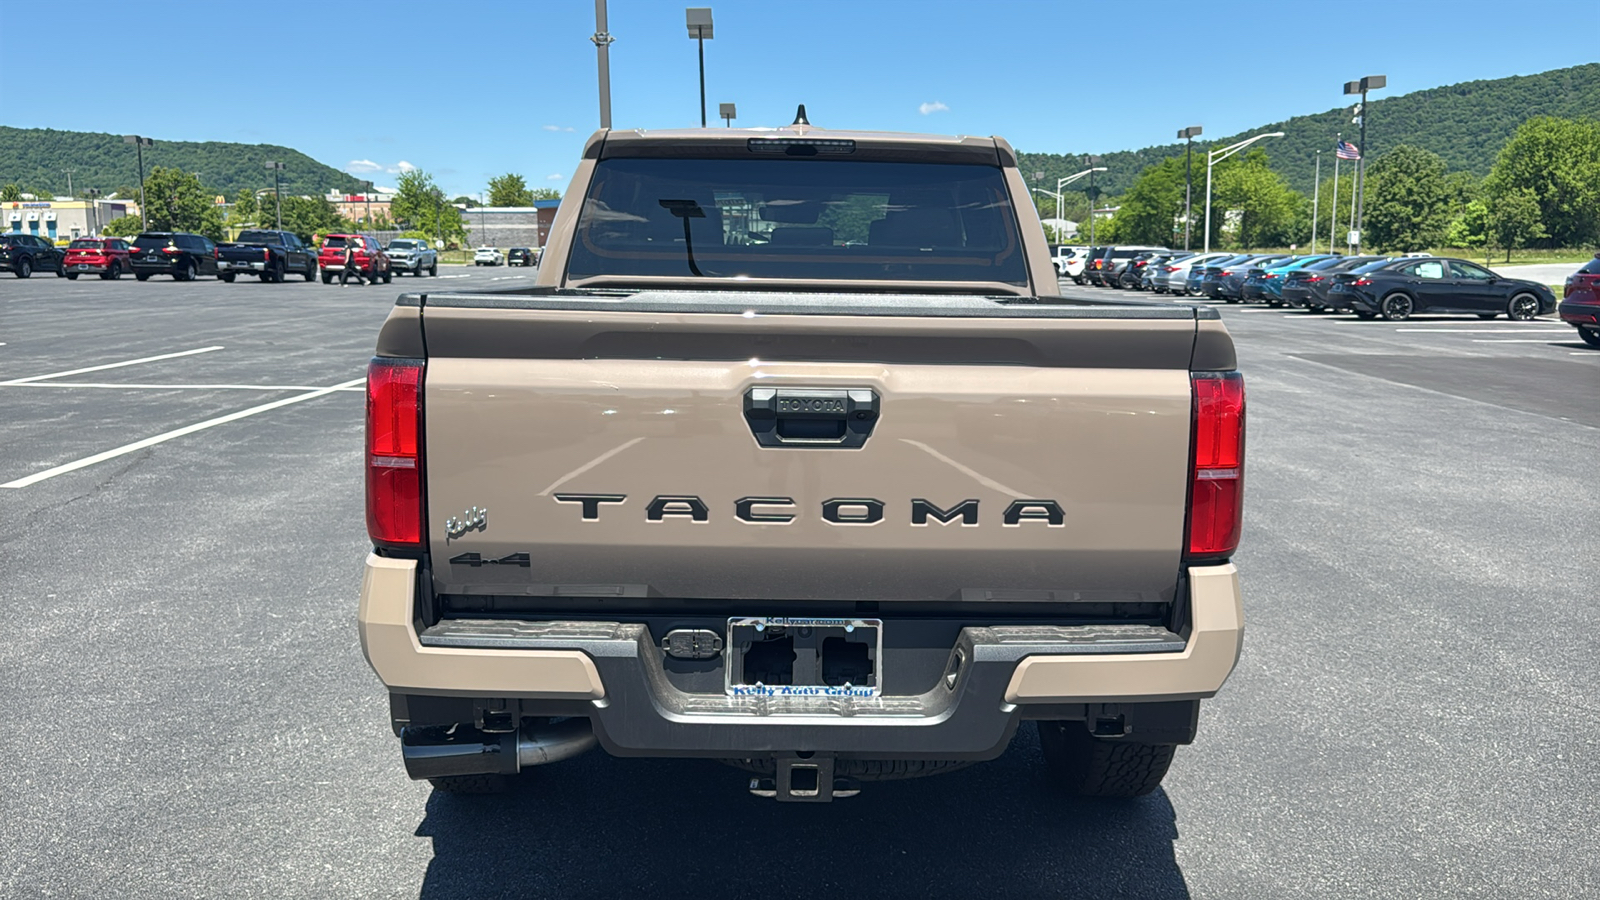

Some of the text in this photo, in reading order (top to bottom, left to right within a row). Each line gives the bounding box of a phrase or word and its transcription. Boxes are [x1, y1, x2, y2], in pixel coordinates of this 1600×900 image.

[778, 398, 845, 412] TOYOTA
[552, 493, 1067, 526] TACOMA
[733, 687, 875, 698] Kelly Auto Group
